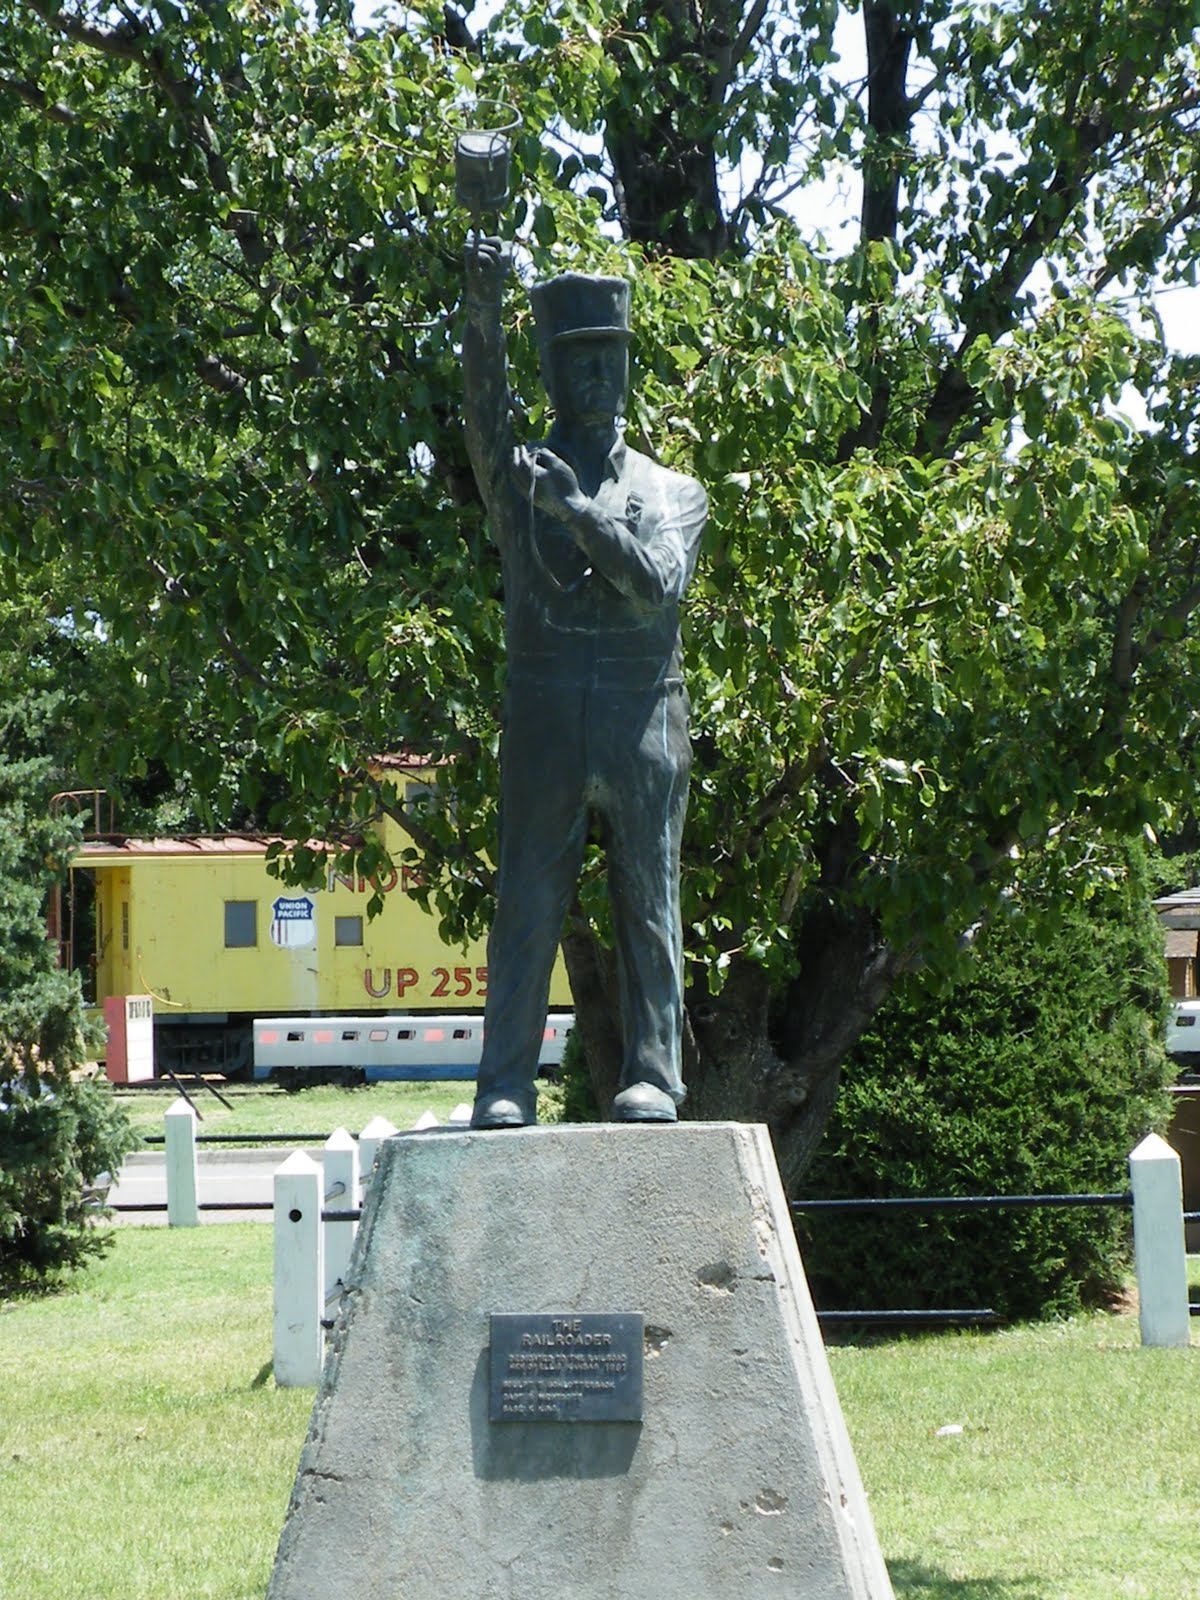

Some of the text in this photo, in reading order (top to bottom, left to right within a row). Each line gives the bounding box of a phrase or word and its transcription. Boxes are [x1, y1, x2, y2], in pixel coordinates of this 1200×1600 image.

[301, 863, 426, 893] NION
[278, 902, 308, 910] UNION
[277, 910, 310, 919] PACIFIC
[364, 967, 419, 999] UP
[552, 1318, 582, 1332] THE
[521, 1333, 613, 1346] RAILROADER
